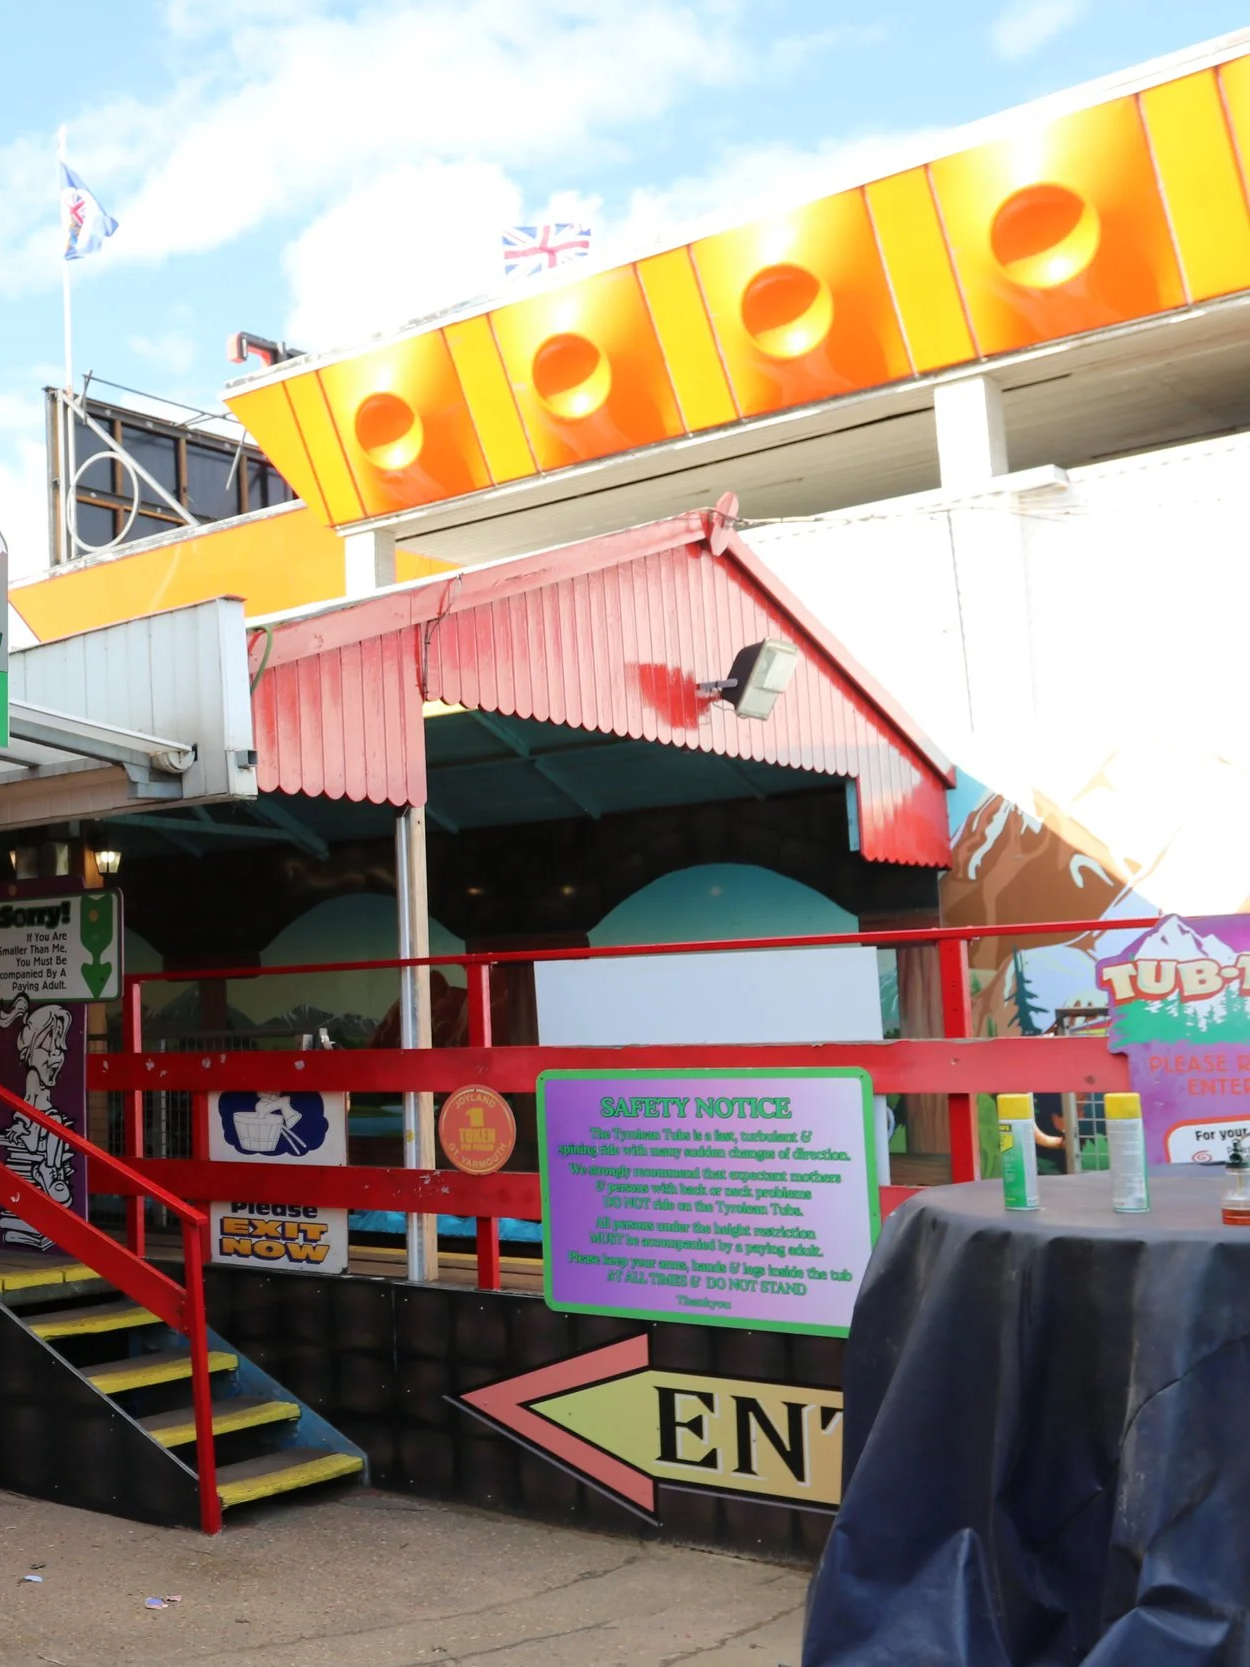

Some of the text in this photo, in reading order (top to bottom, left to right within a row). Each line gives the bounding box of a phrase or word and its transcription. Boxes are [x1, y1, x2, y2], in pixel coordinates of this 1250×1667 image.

[34, 932, 50, 942] You
[52, 932, 67, 941] Are
[30, 944, 49, 954] Than
[16, 955, 67, 967] You Must Be
[46, 968, 57, 979] By
[60, 967, 67, 977] A
[12, 980, 67, 992] Paying Adult.
[1149, 1055, 1228, 1074] PLEASE
[456, 1092, 496, 1109] JOYLAND
[600, 1096, 793, 1119] SAFETY NOTICE
[465, 1107, 484, 1127] 1
[458, 1127, 496, 1144] TOKEN
[590, 1127, 611, 1140] The
[612, 1127, 661, 1142] Tyrolean
[662, 1127, 690, 1141] Tubs
[740, 1130, 798, 1143] turbulent
[800, 1130, 813, 1143] &
[1195, 1128, 1247, 1141] For your
[461, 1142, 507, 1168] YARMOUTH
[599, 1143, 620, 1156] ride
[622, 1144, 648, 1156] with
[650, 1147, 682, 1159] many
[684, 1145, 726, 1158] sudden
[728, 1146, 775, 1162] changes
[777, 1147, 791, 1159] of
[792, 1147, 851, 1161] direction.
[568, 1162, 842, 1183] We strongly recommend that expectant mothers
[608, 1182, 649, 1195] persons
[650, 1182, 678, 1195] with
[679, 1183, 708, 1196] back
[709, 1187, 722, 1196] or
[724, 1185, 754, 1197] neck
[755, 1186, 812, 1200] problems
[230, 1201, 318, 1219] Please
[603, 1195, 804, 1216] DO NOT ride on the Tyrolean Tubs.
[219, 1217, 329, 1243] EXIT
[596, 1216, 816, 1240] All persons under the height restriction
[219, 1236, 330, 1265] NOW
[589, 1232, 824, 1258] MUST be accompanied by a paying adult.
[568, 1250, 601, 1265] Please
[602, 1253, 629, 1269] keep
[630, 1258, 656, 1270] your
[691, 1259, 727, 1273] hands
[729, 1261, 741, 1274] &
[742, 1262, 766, 1278] legs
[768, 1264, 805, 1279] inside
[806, 1266, 828, 1280] the
[829, 1268, 853, 1282] tub
[607, 1270, 808, 1296] AT ALL TIMES & DO NOT STAND
[653, 1385, 844, 1487] EN
